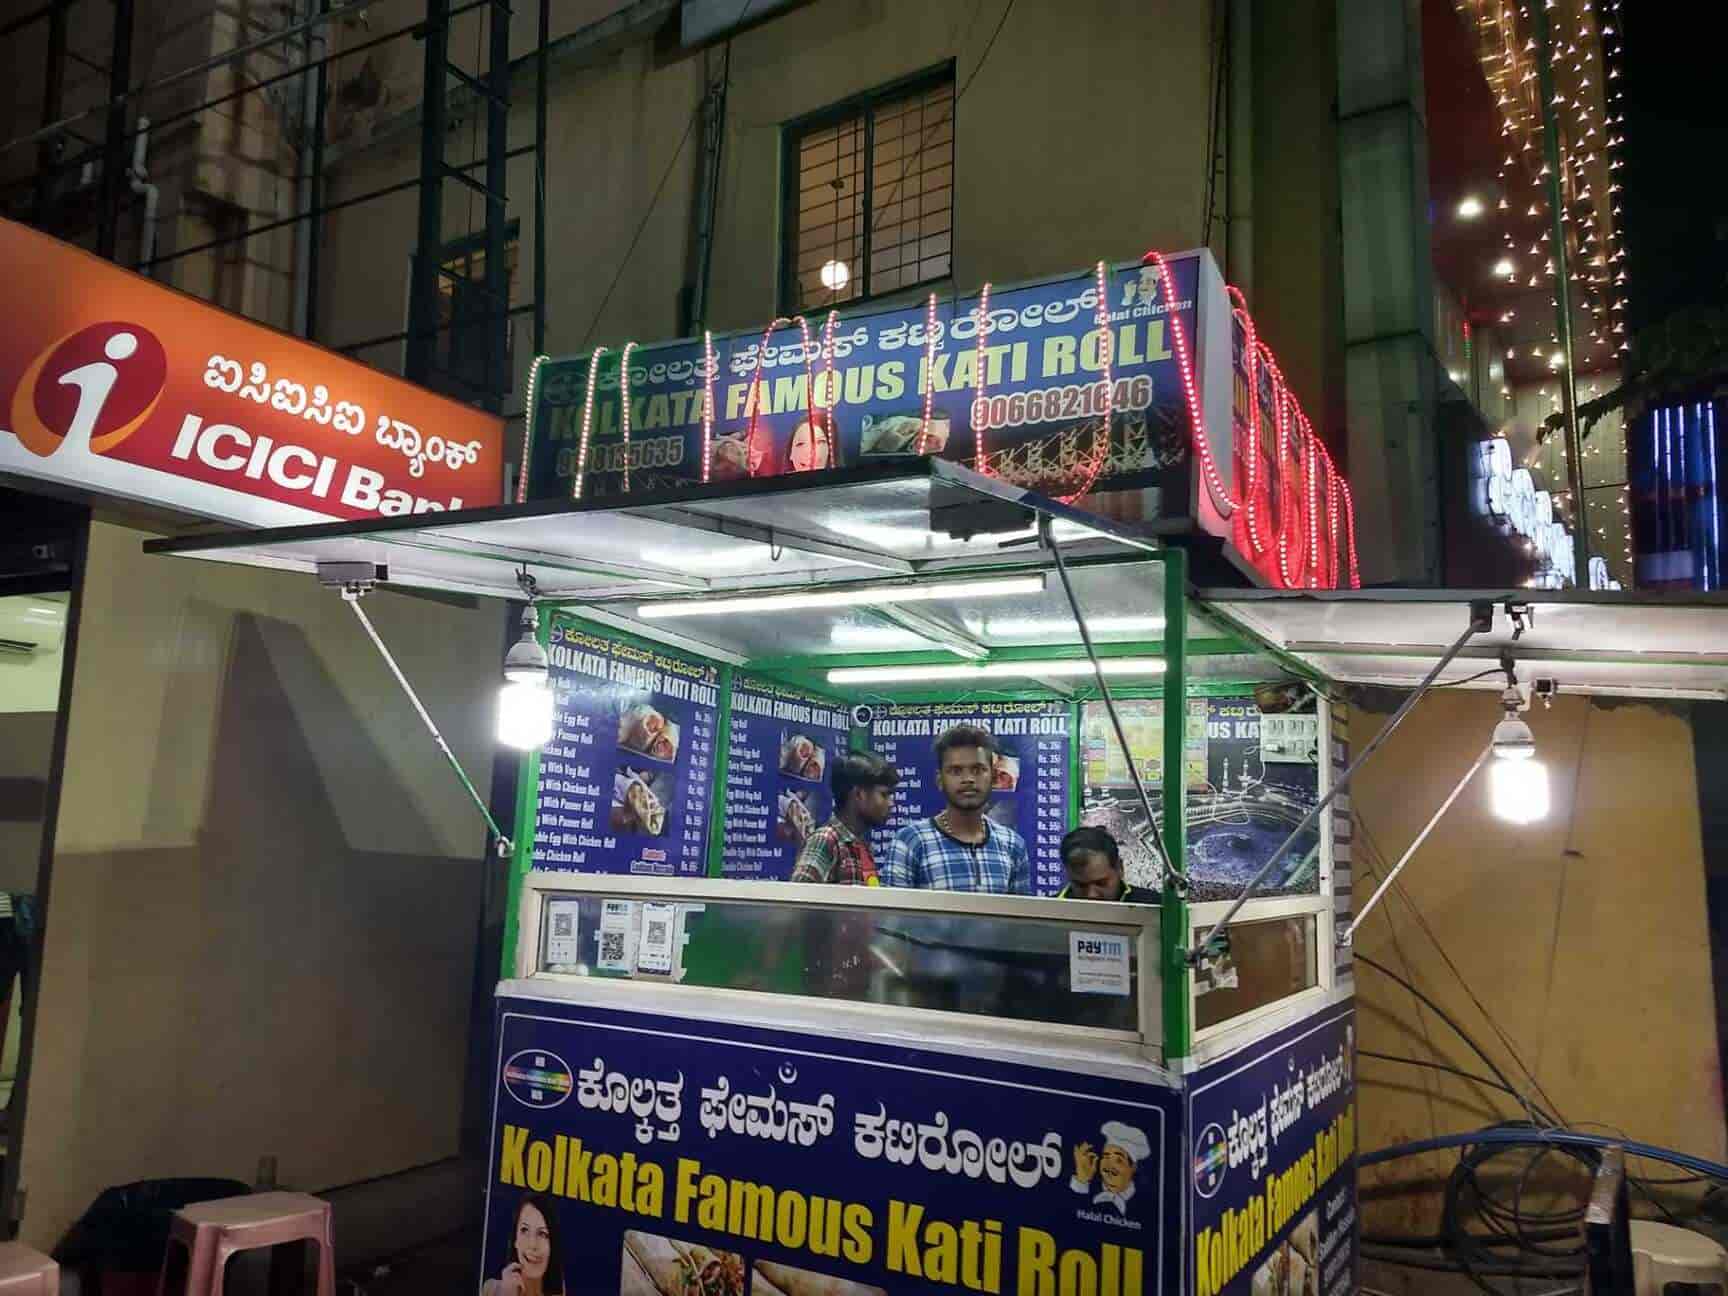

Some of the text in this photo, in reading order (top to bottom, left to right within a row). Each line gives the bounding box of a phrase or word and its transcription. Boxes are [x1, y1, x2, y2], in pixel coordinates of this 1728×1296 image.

[726, 361, 906, 420] FAMOUS
[918, 341, 1029, 396] KATI
[1042, 320, 1172, 379] ROLL
[170, 413, 337, 499] ICICI
[204, 354, 483, 479] ಐಸಿಐಸಿಐ ಬ್ಯಾಂಕ್
[610, 659, 662, 693] FAMOUS
[663, 674, 690, 701] KATI
[690, 682, 718, 708] ROLL
[731, 692, 773, 716] KOLKATA
[773, 699, 811, 724] FAMOUS
[873, 718, 930, 736] KOLKATA
[994, 718, 1026, 735] KATI
[1030, 716, 1067, 735] ROLL
[500, 1124, 1143, 1296] Kolkata Famous Kati Roll
[1103, 1214, 1142, 1230] Chicken
[1196, 1194, 1265, 1296] Kolkata
